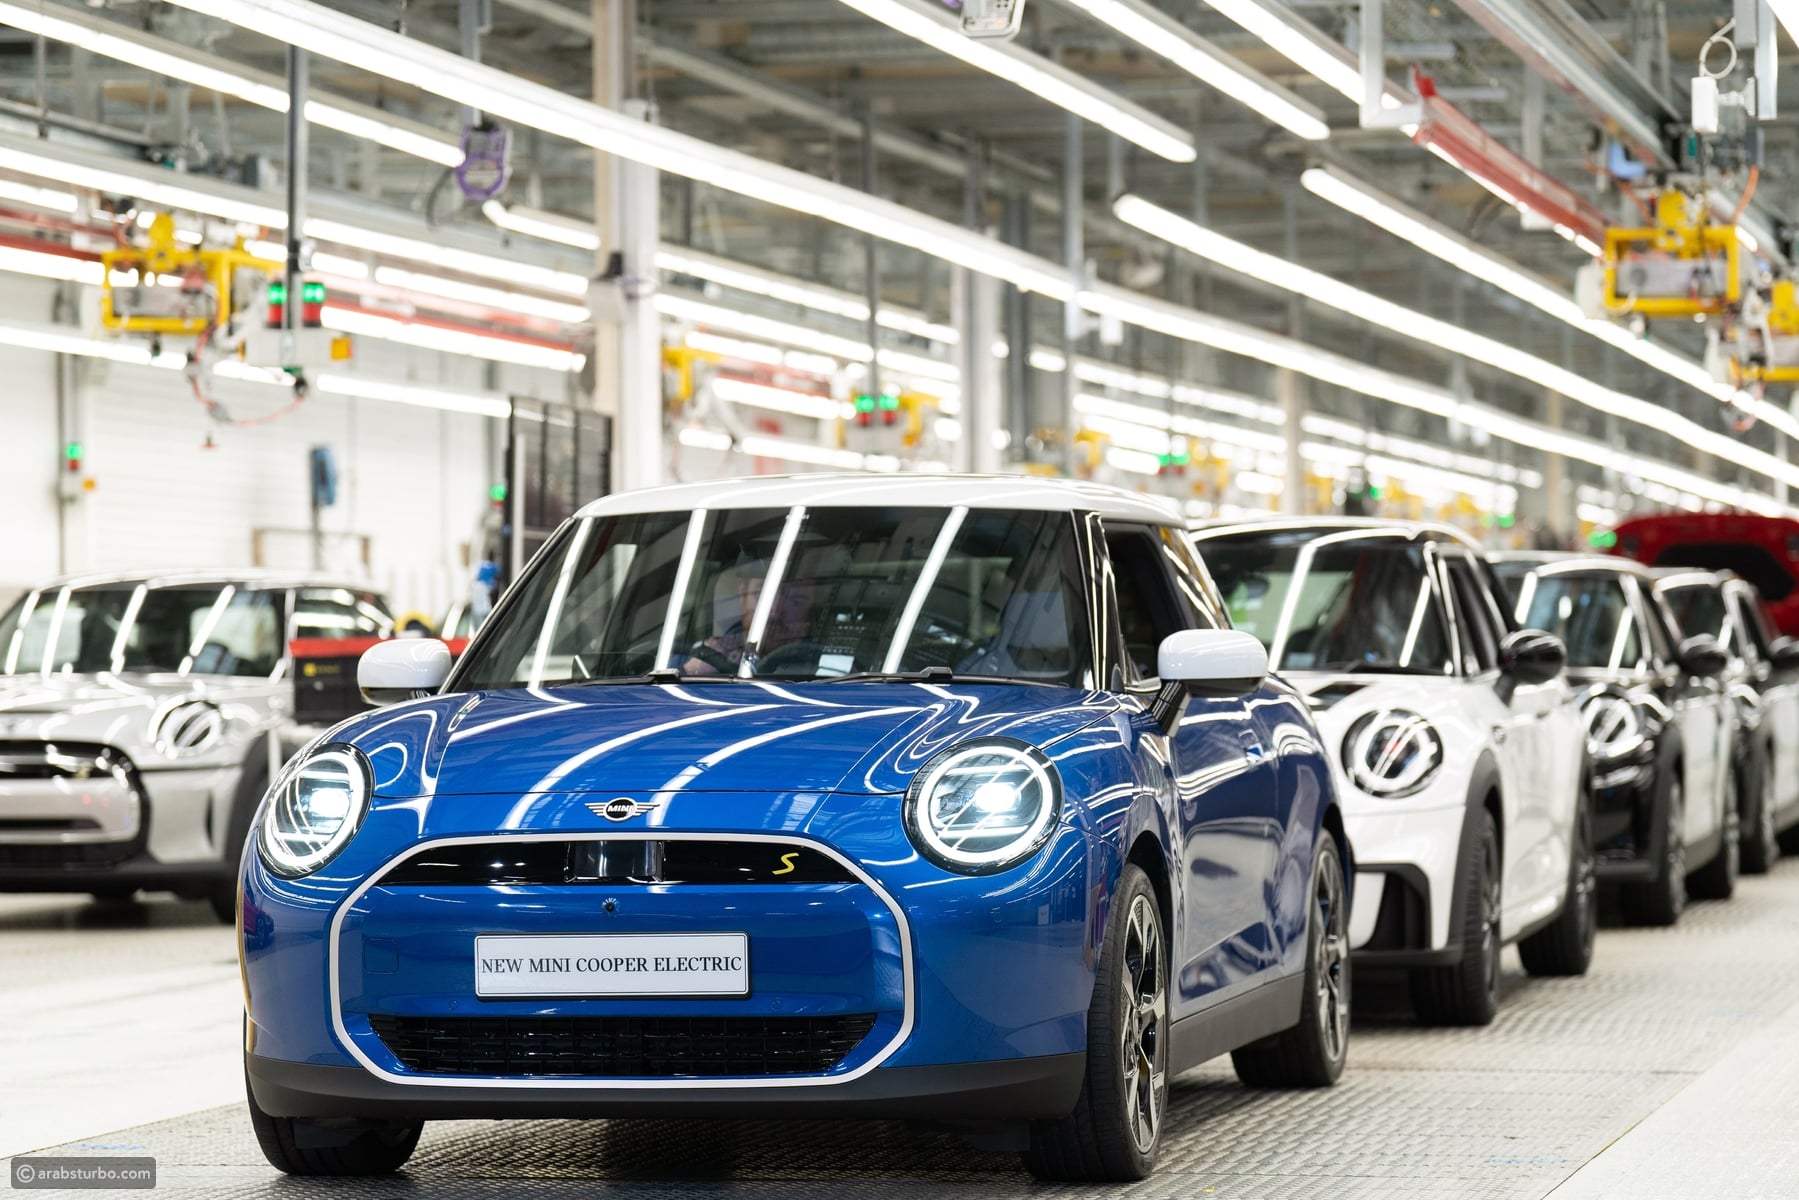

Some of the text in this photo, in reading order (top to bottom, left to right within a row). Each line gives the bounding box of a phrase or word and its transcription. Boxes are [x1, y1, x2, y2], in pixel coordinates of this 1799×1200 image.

[772, 852, 799, 875] S
[481, 956, 742, 973] NEW MINI COOPER ELECTRIC
